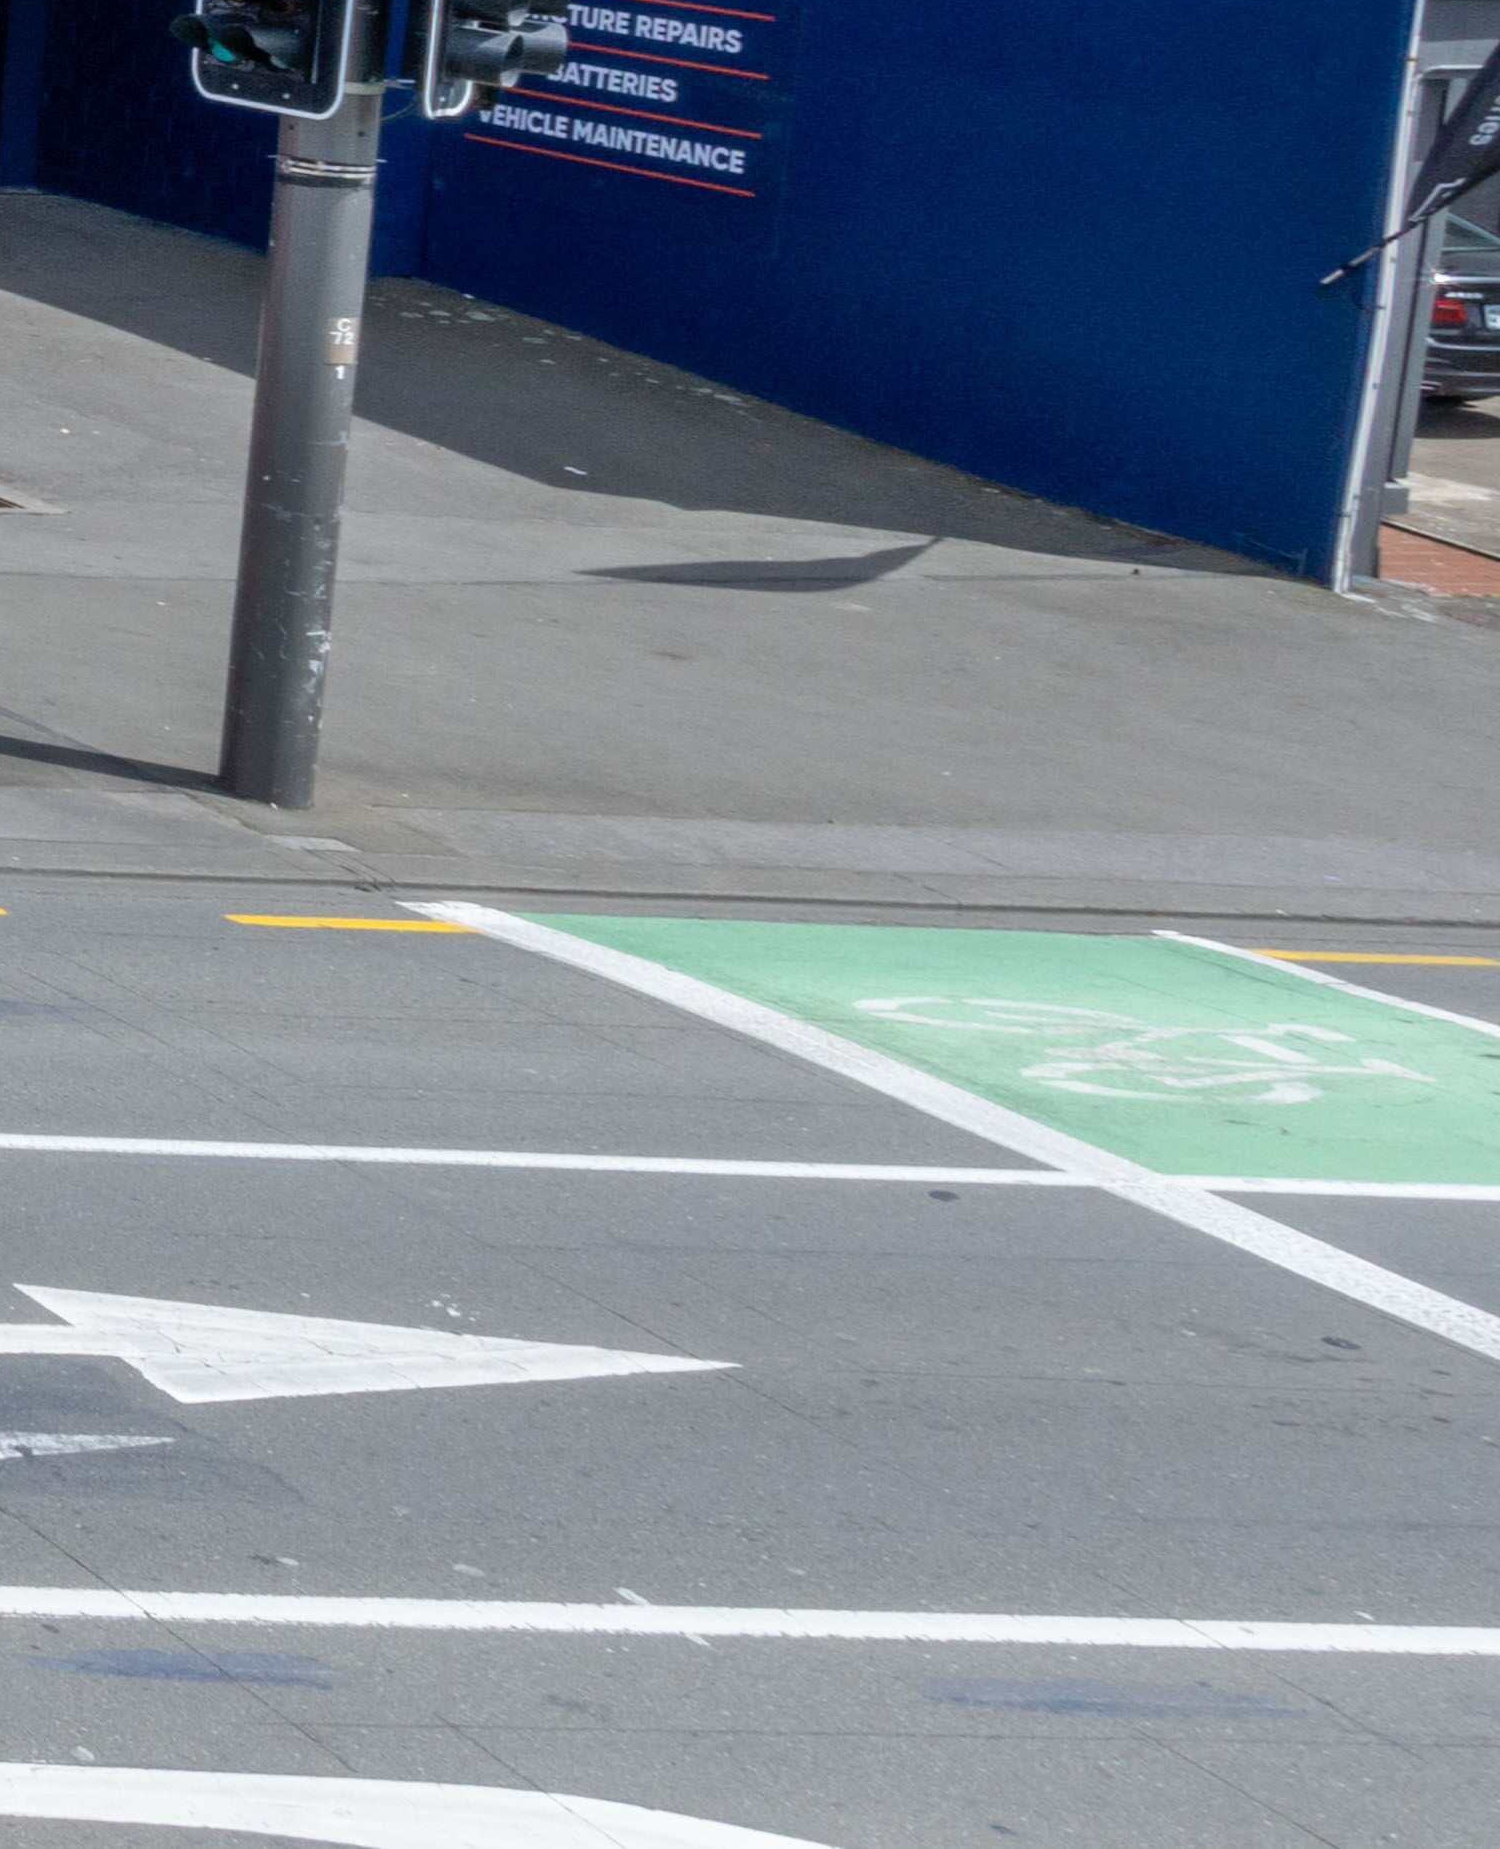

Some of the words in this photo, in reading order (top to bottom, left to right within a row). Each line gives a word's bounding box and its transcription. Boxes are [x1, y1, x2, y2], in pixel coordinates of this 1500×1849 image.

[635, 15, 743, 53] REPAIRS
[547, 62, 678, 103] BATTERIES
[479, 104, 570, 138] VEHICLE
[572, 120, 746, 175] MAINTENANCE
[329, 331, 355, 345] 72
[337, 318, 351, 332] C
[335, 365, 345, 380] 1
